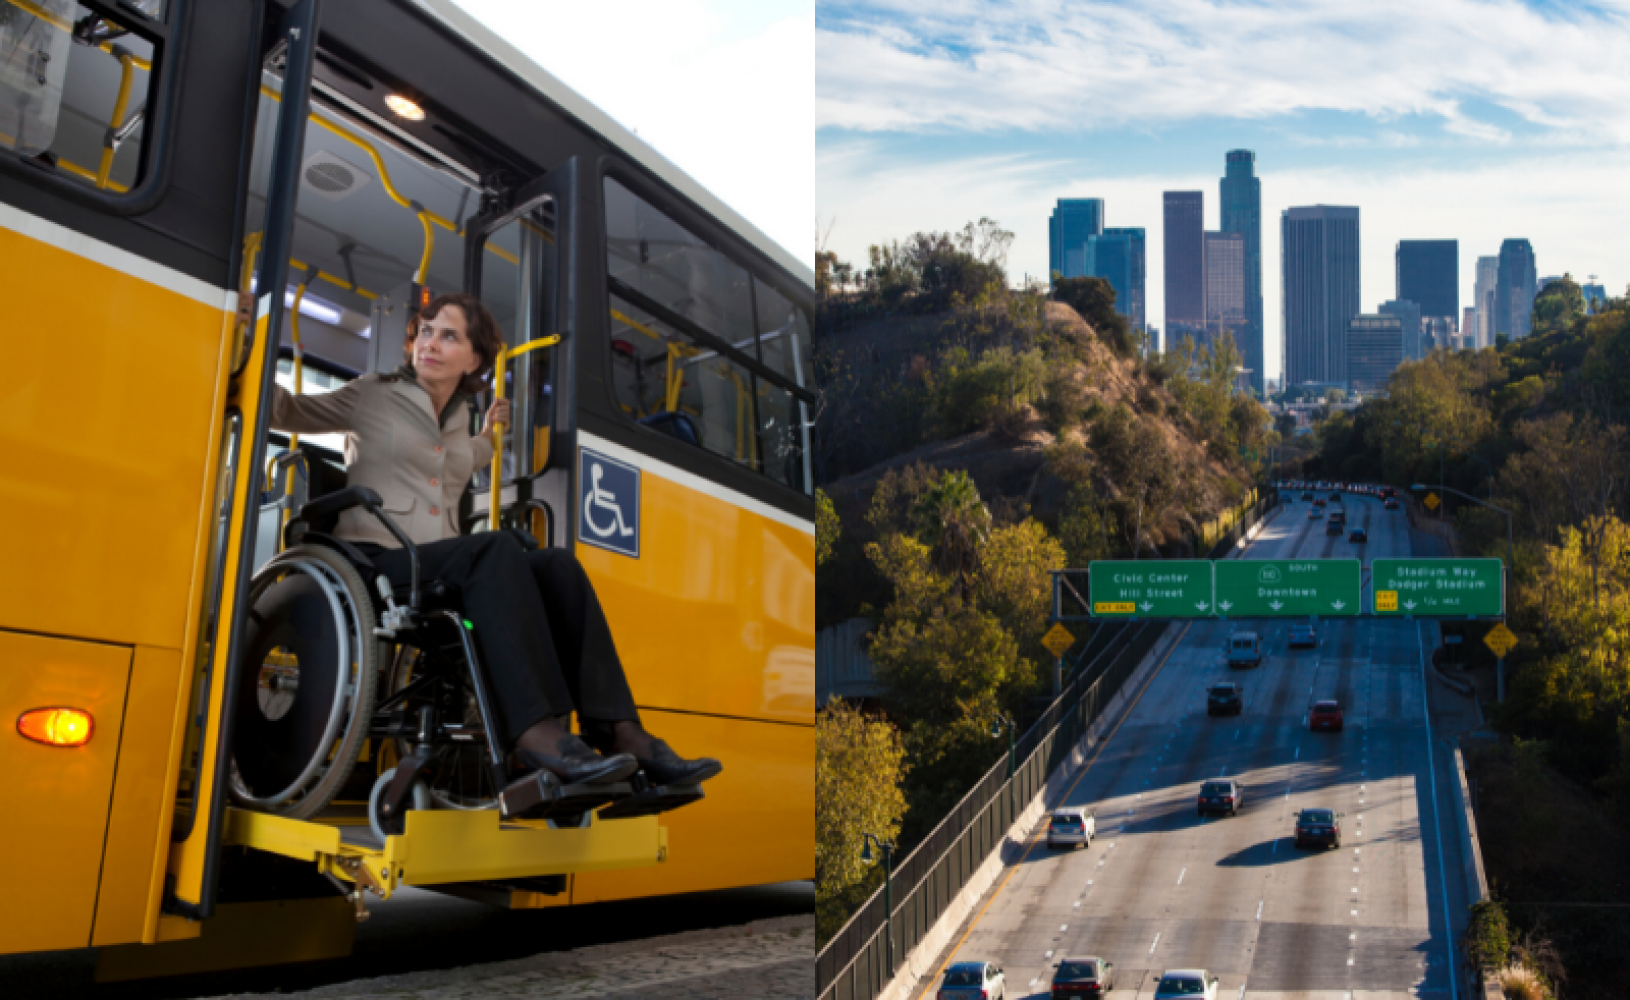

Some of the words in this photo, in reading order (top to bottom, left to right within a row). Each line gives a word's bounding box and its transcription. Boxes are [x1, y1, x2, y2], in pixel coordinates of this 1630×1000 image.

[1397, 566, 1447, 577] Stadium
[1453, 566, 1477, 578] Way
[1113, 573, 1143, 583] Civic
[1149, 573, 1188, 583] Center
[1389, 579, 1430, 591] Dodger
[1436, 579, 1486, 590] Stadium
[1120, 588, 1141, 598] Hill
[1147, 588, 1183, 598] Street
[1257, 587, 1317, 597] Downtown
